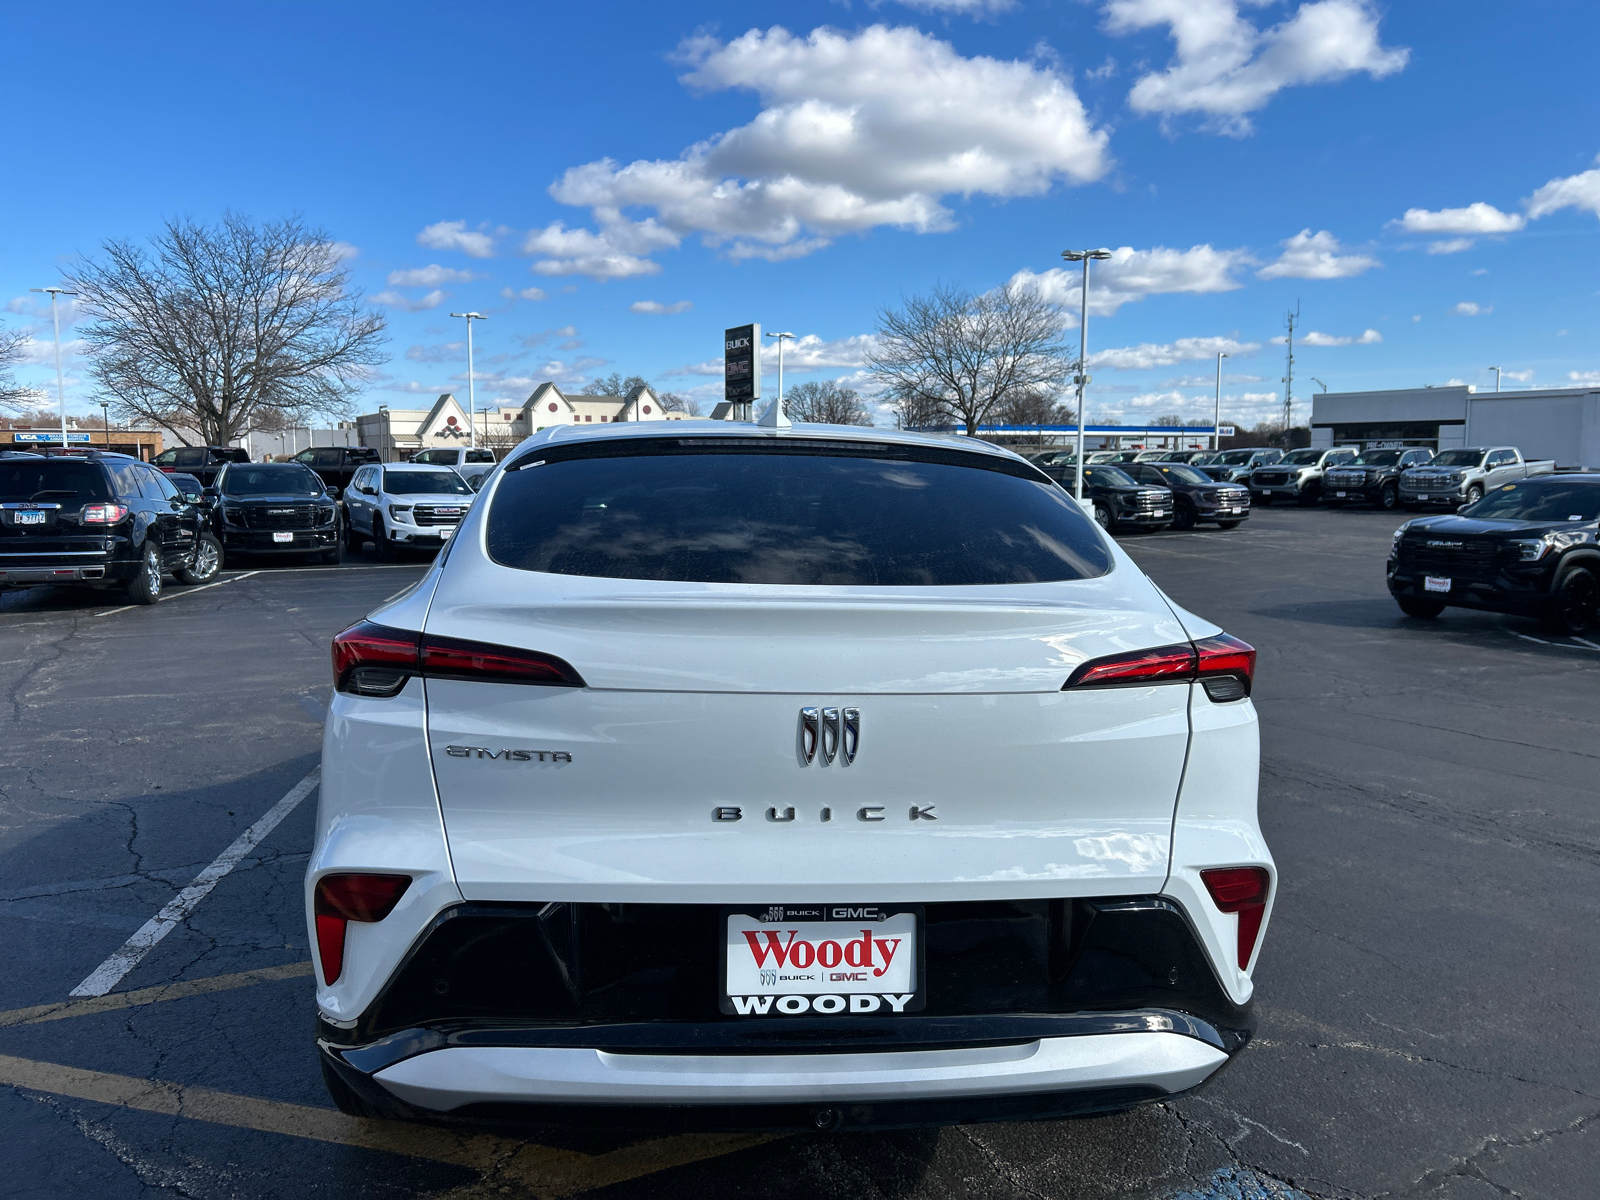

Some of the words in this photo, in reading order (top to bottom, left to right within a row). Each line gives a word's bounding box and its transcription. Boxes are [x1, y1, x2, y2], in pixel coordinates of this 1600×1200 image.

[726, 337, 750, 350] BUICK
[727, 360, 749, 376] GMC
[1366, 441, 1404, 449] PRE-OWNED
[446, 745, 572, 763] ENVISTA
[712, 805, 939, 822] BUICK
[832, 907, 879, 918] GMC
[741, 929, 902, 977] Woody
[829, 972, 867, 982] GMC
[731, 994, 914, 1015] WOODY
